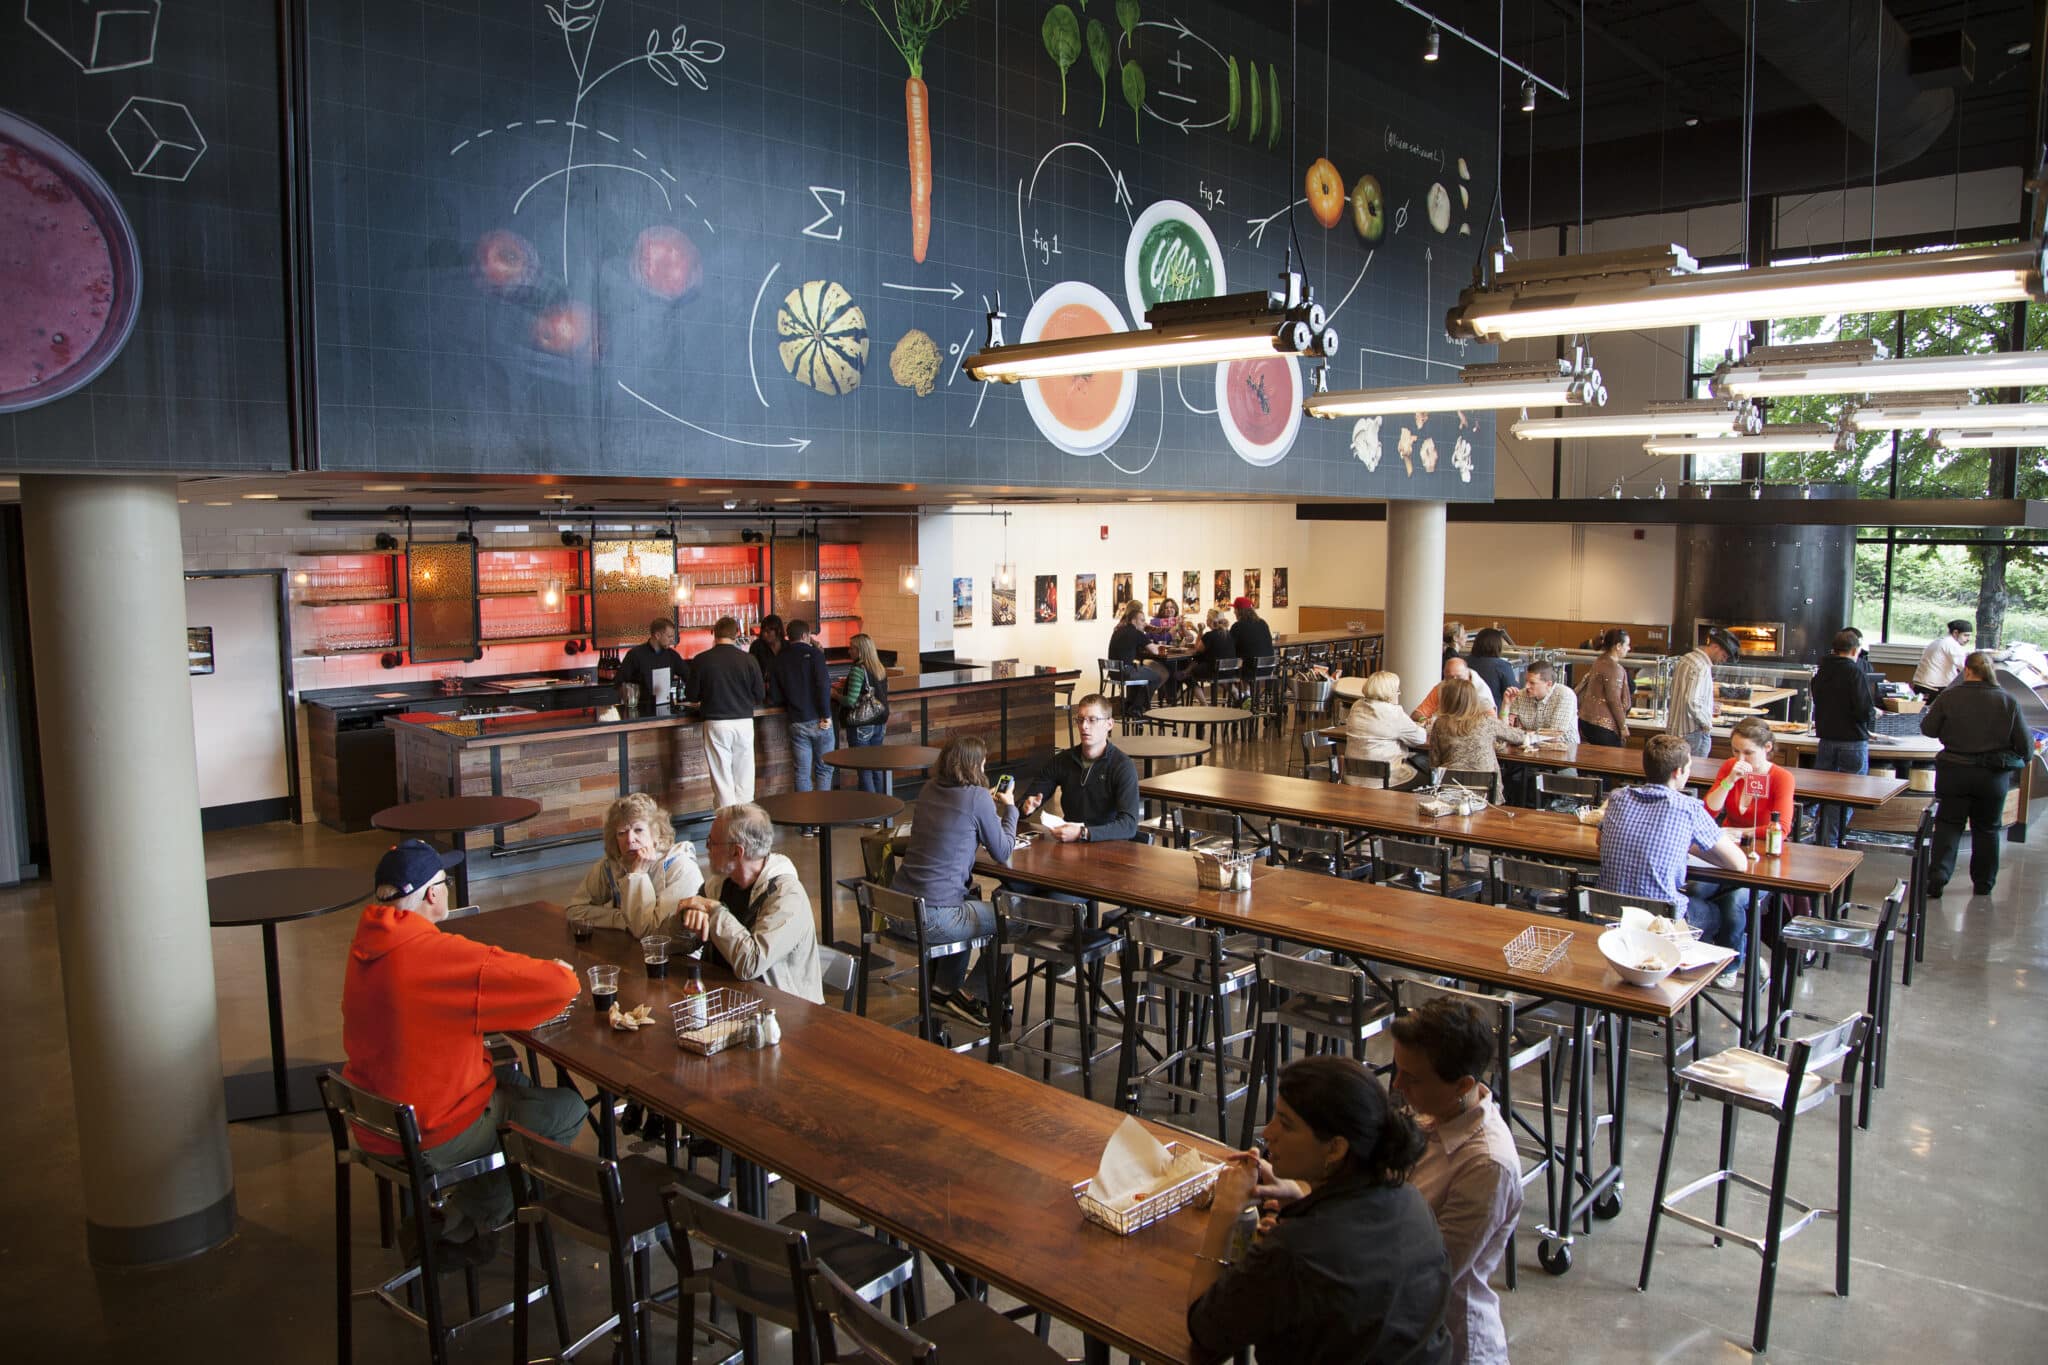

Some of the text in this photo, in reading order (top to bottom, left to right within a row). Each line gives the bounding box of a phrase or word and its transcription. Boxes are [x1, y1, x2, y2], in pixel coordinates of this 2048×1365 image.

[1199, 181, 1225, 211] fig 2
[1033, 229, 1062, 265] fig 1
[1750, 781, 1763, 790] Ch
